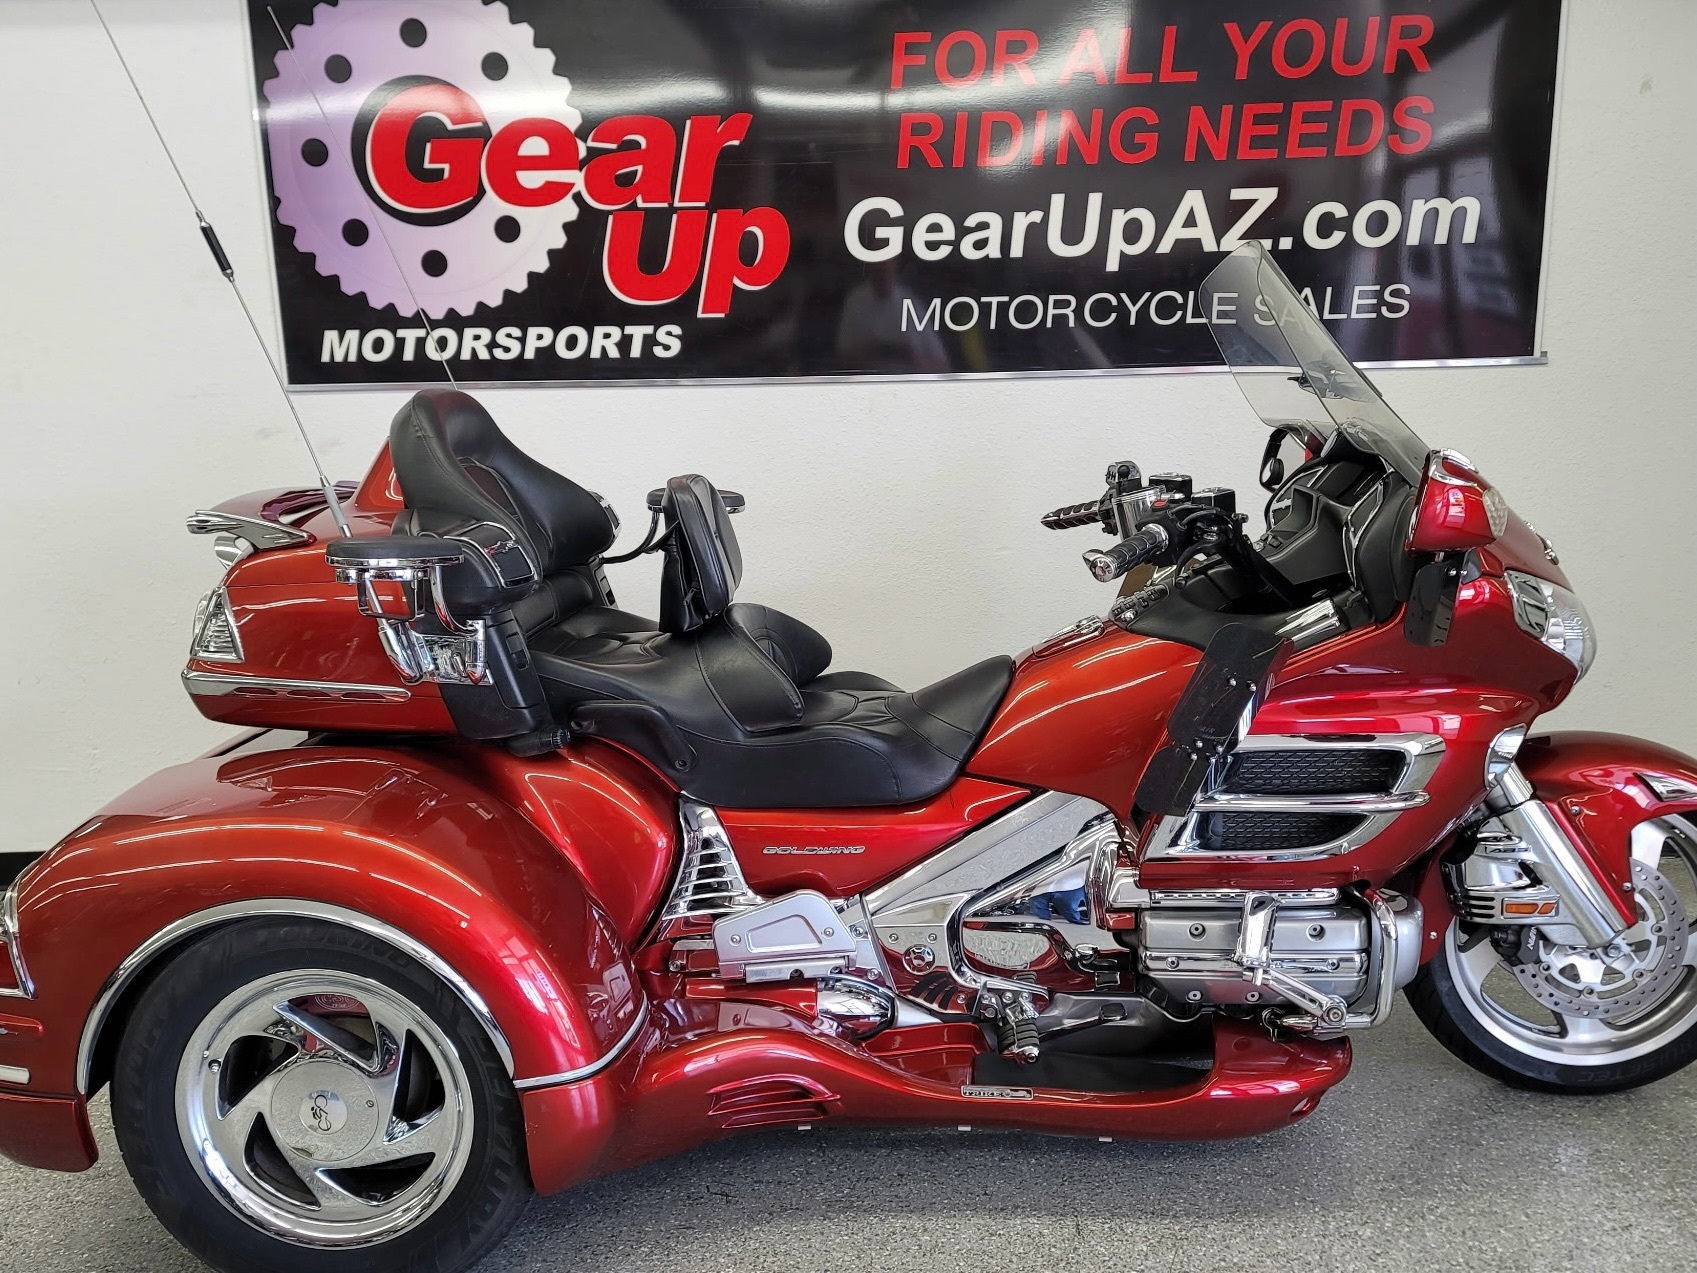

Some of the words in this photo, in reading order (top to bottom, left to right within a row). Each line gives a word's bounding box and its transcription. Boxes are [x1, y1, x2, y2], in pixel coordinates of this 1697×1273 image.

[890, 28, 1039, 90] FOR
[1058, 24, 1198, 86] ALL
[1223, 14, 1434, 80] YOUR
[366, 84, 754, 215] Gear
[897, 106, 1160, 169] RIDING
[1184, 95, 1434, 162] NEEDS
[603, 207, 791, 319] Up
[844, 186, 1481, 272] GearUpAZ.com
[320, 324, 685, 364] MOTORSPORTS
[901, 290, 1237, 333] MOTORCYCLE
[1256, 283, 1411, 327] SALES
